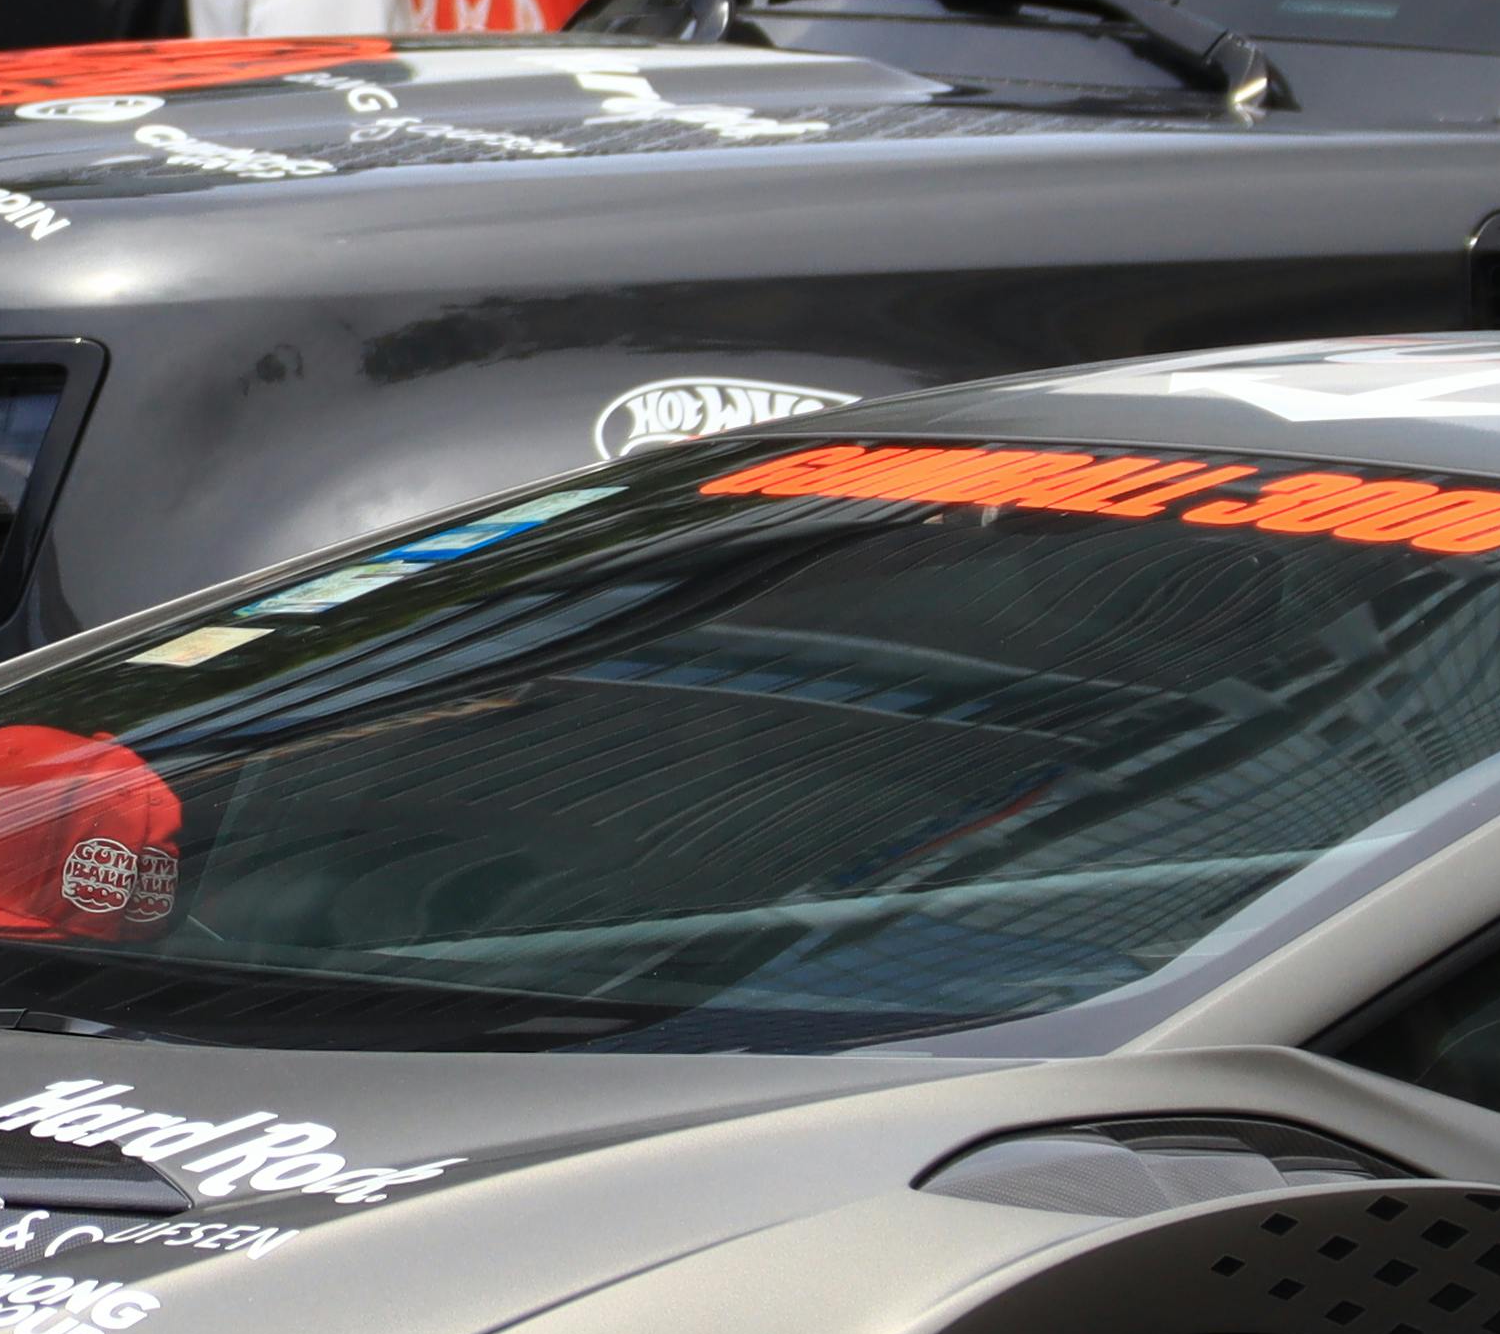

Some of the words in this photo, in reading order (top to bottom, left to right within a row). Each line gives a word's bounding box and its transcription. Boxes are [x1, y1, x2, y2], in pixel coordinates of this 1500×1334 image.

[698, 445, 1258, 519] GUMBALL
[74, 842, 139, 872] GUM
[198, 1122, 469, 1204] Rock
[44, 1221, 300, 1261] OUFSEN
